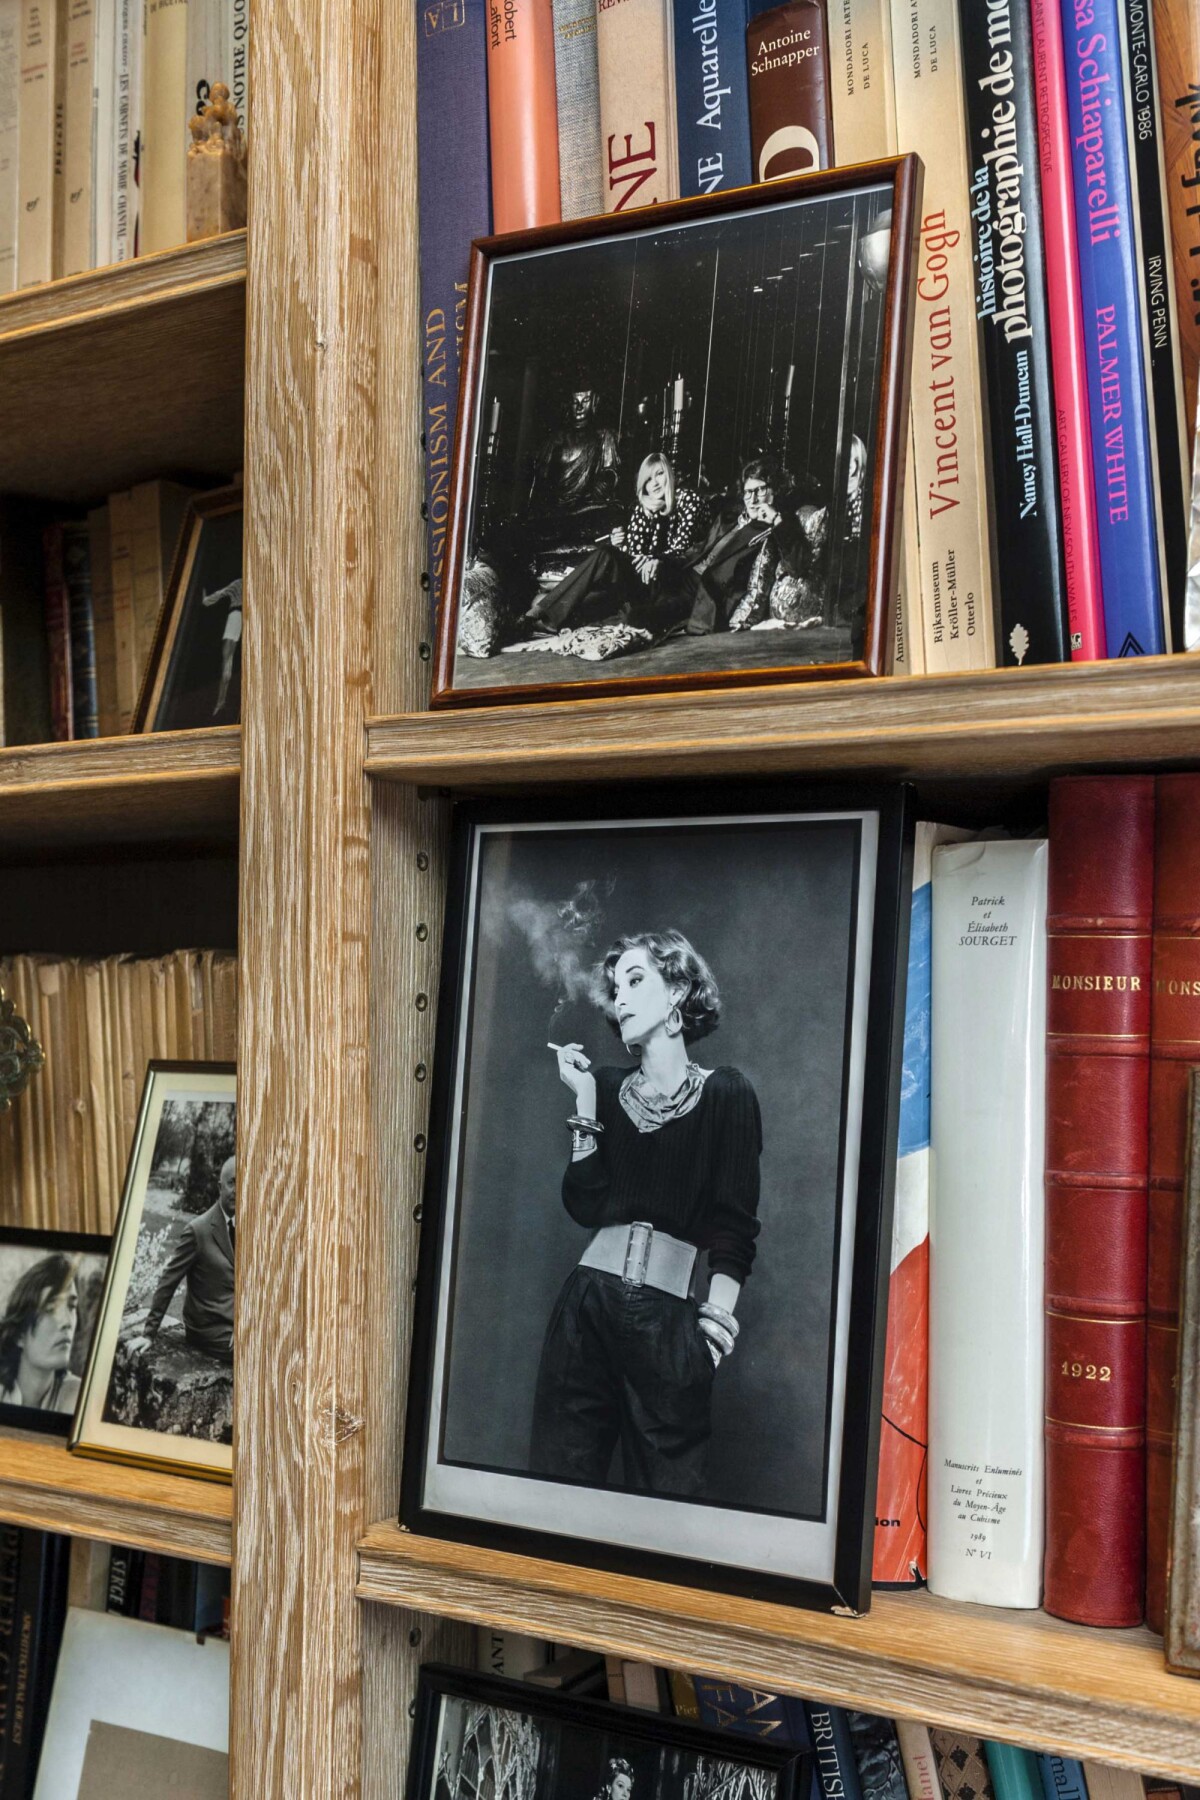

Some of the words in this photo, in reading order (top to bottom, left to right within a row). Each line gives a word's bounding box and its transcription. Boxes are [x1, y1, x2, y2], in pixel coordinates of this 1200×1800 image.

[503, 0, 518, 42] obert
[929, 25, 938, 56] LUCA
[751, 45, 821, 77] Schnapper
[757, 29, 812, 56] Antoine
[844, 28, 855, 97] MONDADORI
[861, 42, 871, 73] LUCA
[910, 11, 922, 80] MONDADORI
[1036, 30, 1048, 84] LAURENT
[692, 0, 732, 131] Aquarelle
[862, 75, 872, 91] DE
[930, 57, 939, 73] DE
[977, 49, 1014, 97] de
[1039, 86, 1053, 175] RETROSPECTIVE
[1075, 33, 1122, 246] Schiaparelli
[1136, 105, 1153, 141] 1986
[970, 165, 990, 196] la
[971, 189, 993, 223] de
[980, 100, 1034, 344] photographie
[917, 208, 961, 302] Gogh
[974, 223, 997, 320] histoire
[1147, 254, 1165, 306] IRVING
[426, 308, 447, 388] AND
[929, 305, 953, 372] van
[1151, 307, 1168, 349] PENN
[1096, 303, 1123, 424] PALMER
[1014, 349, 1035, 463] Hall-Duncan
[1058, 409, 1067, 431] ART
[928, 375, 961, 520] Vincent
[1059, 434, 1070, 485] GALLERY
[1019, 462, 1038, 520] Nancy
[1104, 424, 1129, 525] WHITE
[1062, 488, 1071, 505] OF
[1063, 506, 1073, 538] NEW
[1065, 538, 1075, 580] SOUTH
[931, 560, 946, 645] Rijksmuseum
[946, 548, 960, 641] Kröller-Müller
[964, 591, 977, 637] Otterlo
[1067, 580, 1078, 622] WALES
[971, 895, 1006, 906] Patrick
[983, 911, 992, 919] et
[958, 935, 1018, 946] SOURGET
[967, 921, 1009, 933] Élisabeth
[1052, 975, 1141, 991] MONSIEUR
[1061, 1361, 1112, 1381] 1922
[944, 1458, 980, 1472] Manuscrits
[984, 1465, 1023, 1476] Enluminés
[950, 1484, 972, 1496] Livres
[976, 1489, 1008, 1500] Précieux
[953, 1498, 961, 1507] du
[970, 1513, 1001, 1525] Cubisme
